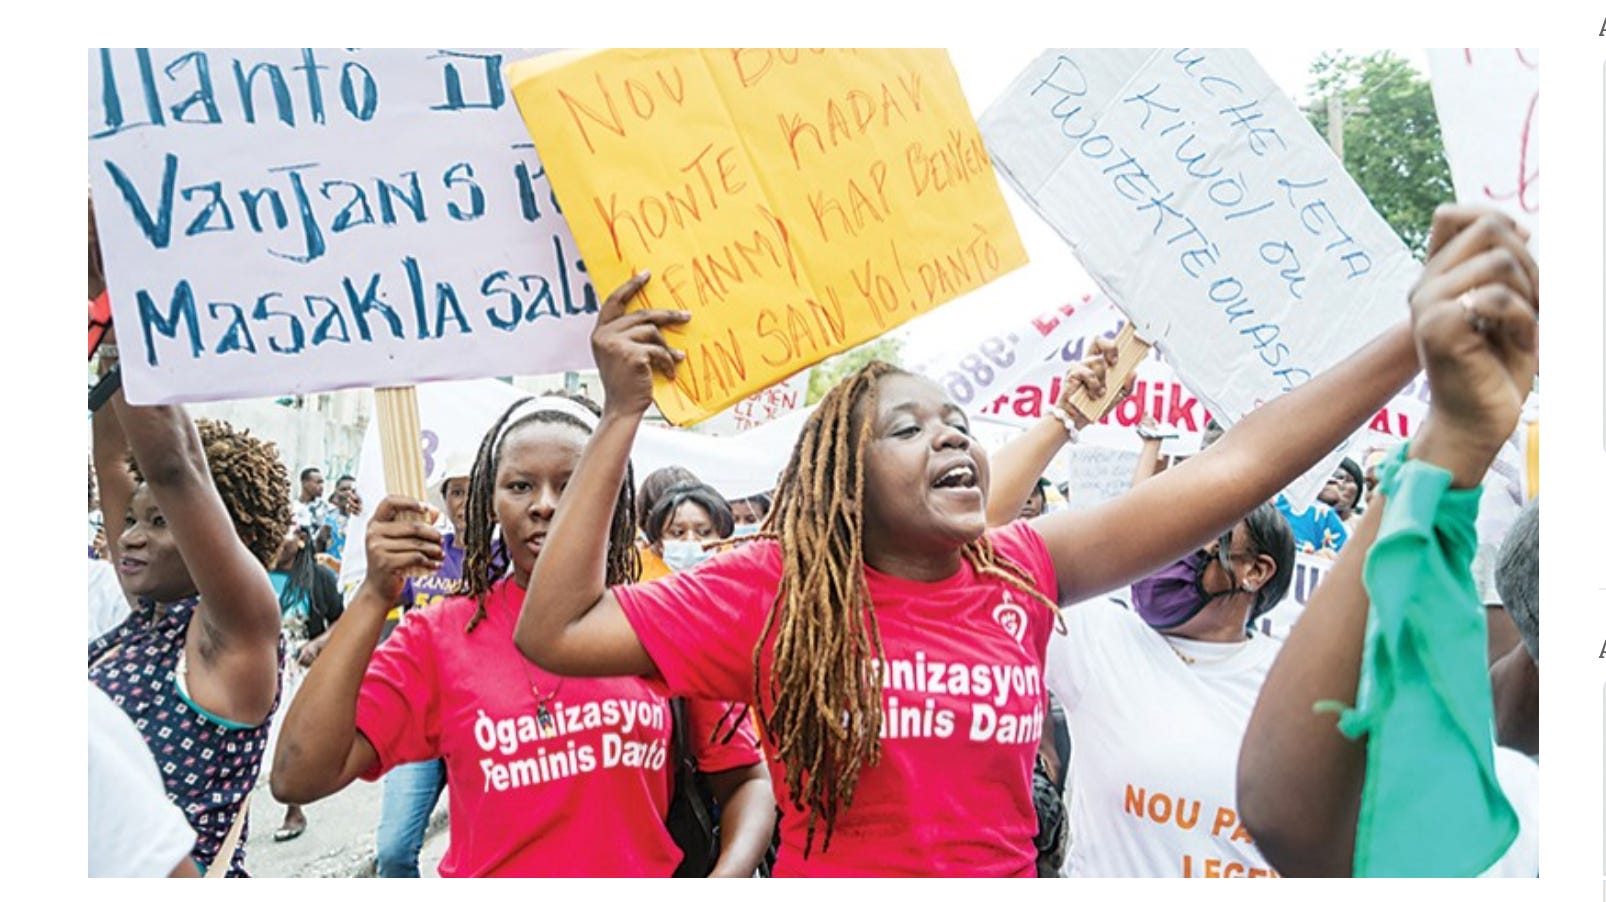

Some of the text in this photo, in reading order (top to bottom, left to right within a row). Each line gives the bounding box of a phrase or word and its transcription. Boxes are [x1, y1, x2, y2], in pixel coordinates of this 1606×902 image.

[593, 142, 747, 263] KONTE
[777, 71, 922, 171] KADAV
[806, 158, 892, 243] KAP
[756, 283, 846, 368] SAN
[850, 238, 918, 330] YO!
[479, 744, 597, 792] Feminis
[1124, 783, 1201, 830] NOU
